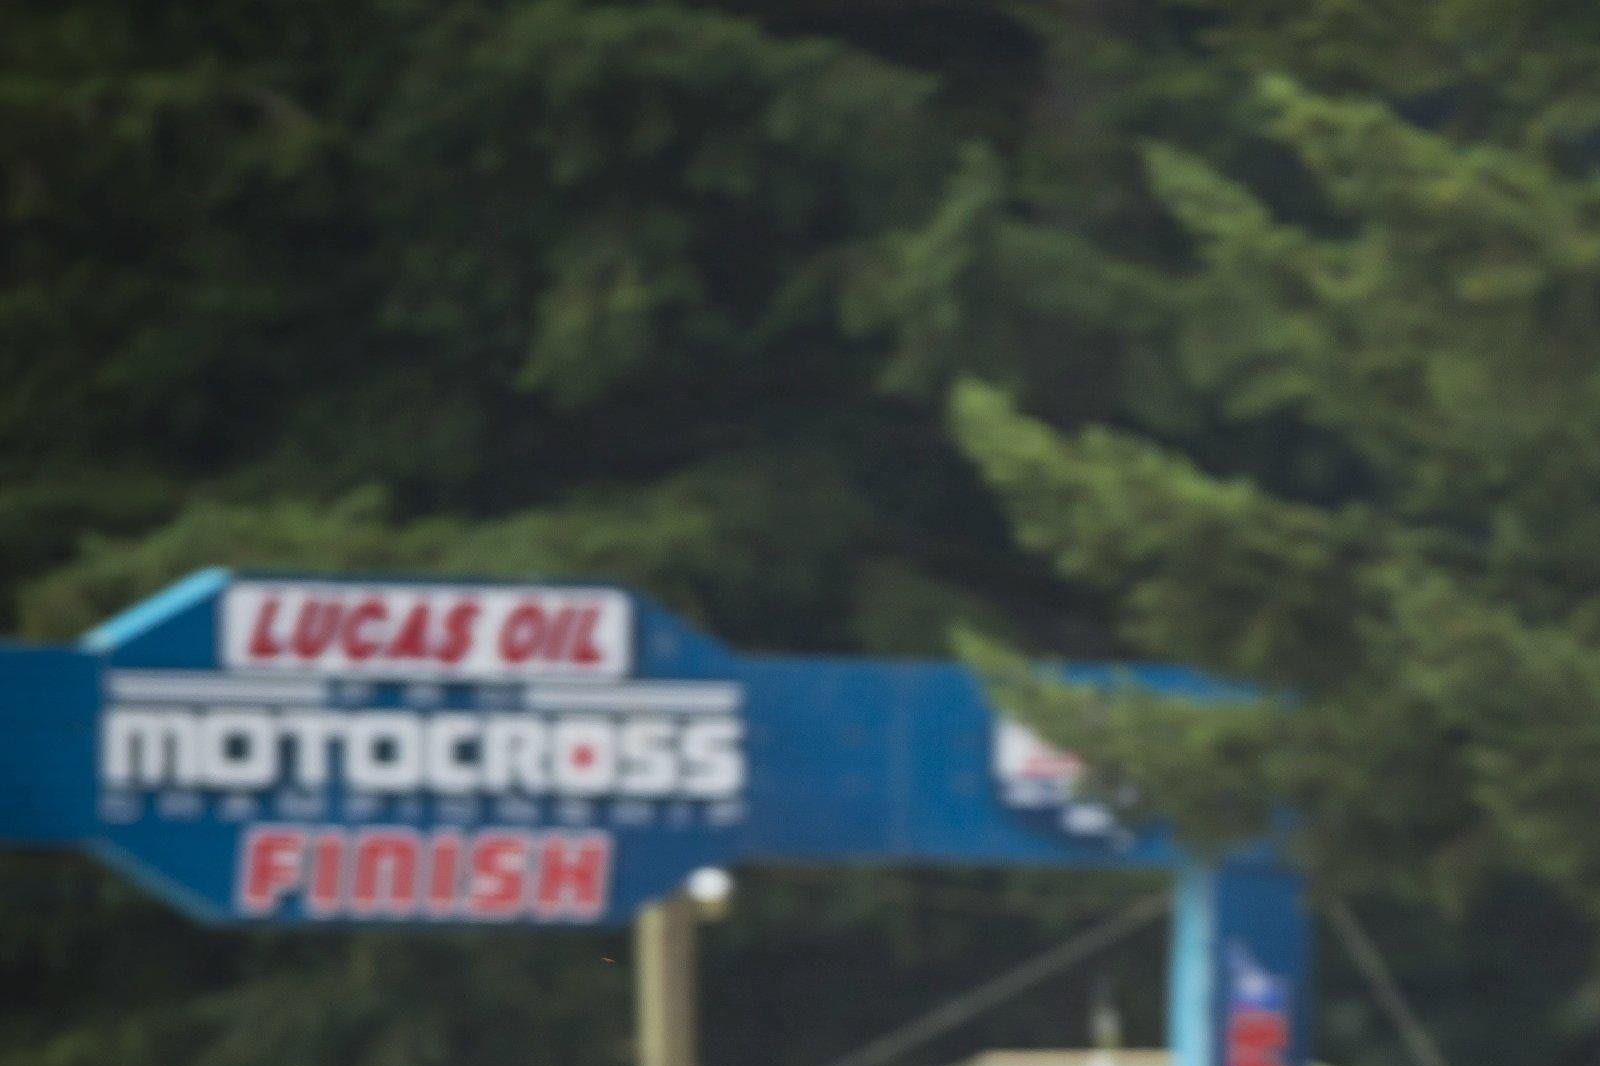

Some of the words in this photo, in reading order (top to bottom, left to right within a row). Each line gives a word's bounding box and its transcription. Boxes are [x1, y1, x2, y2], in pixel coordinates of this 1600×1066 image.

[247, 595, 474, 665] LUCAS
[496, 595, 607, 668] OIL
[102, 708, 747, 798] MOTOCROSS
[240, 828, 611, 921] FINISH
